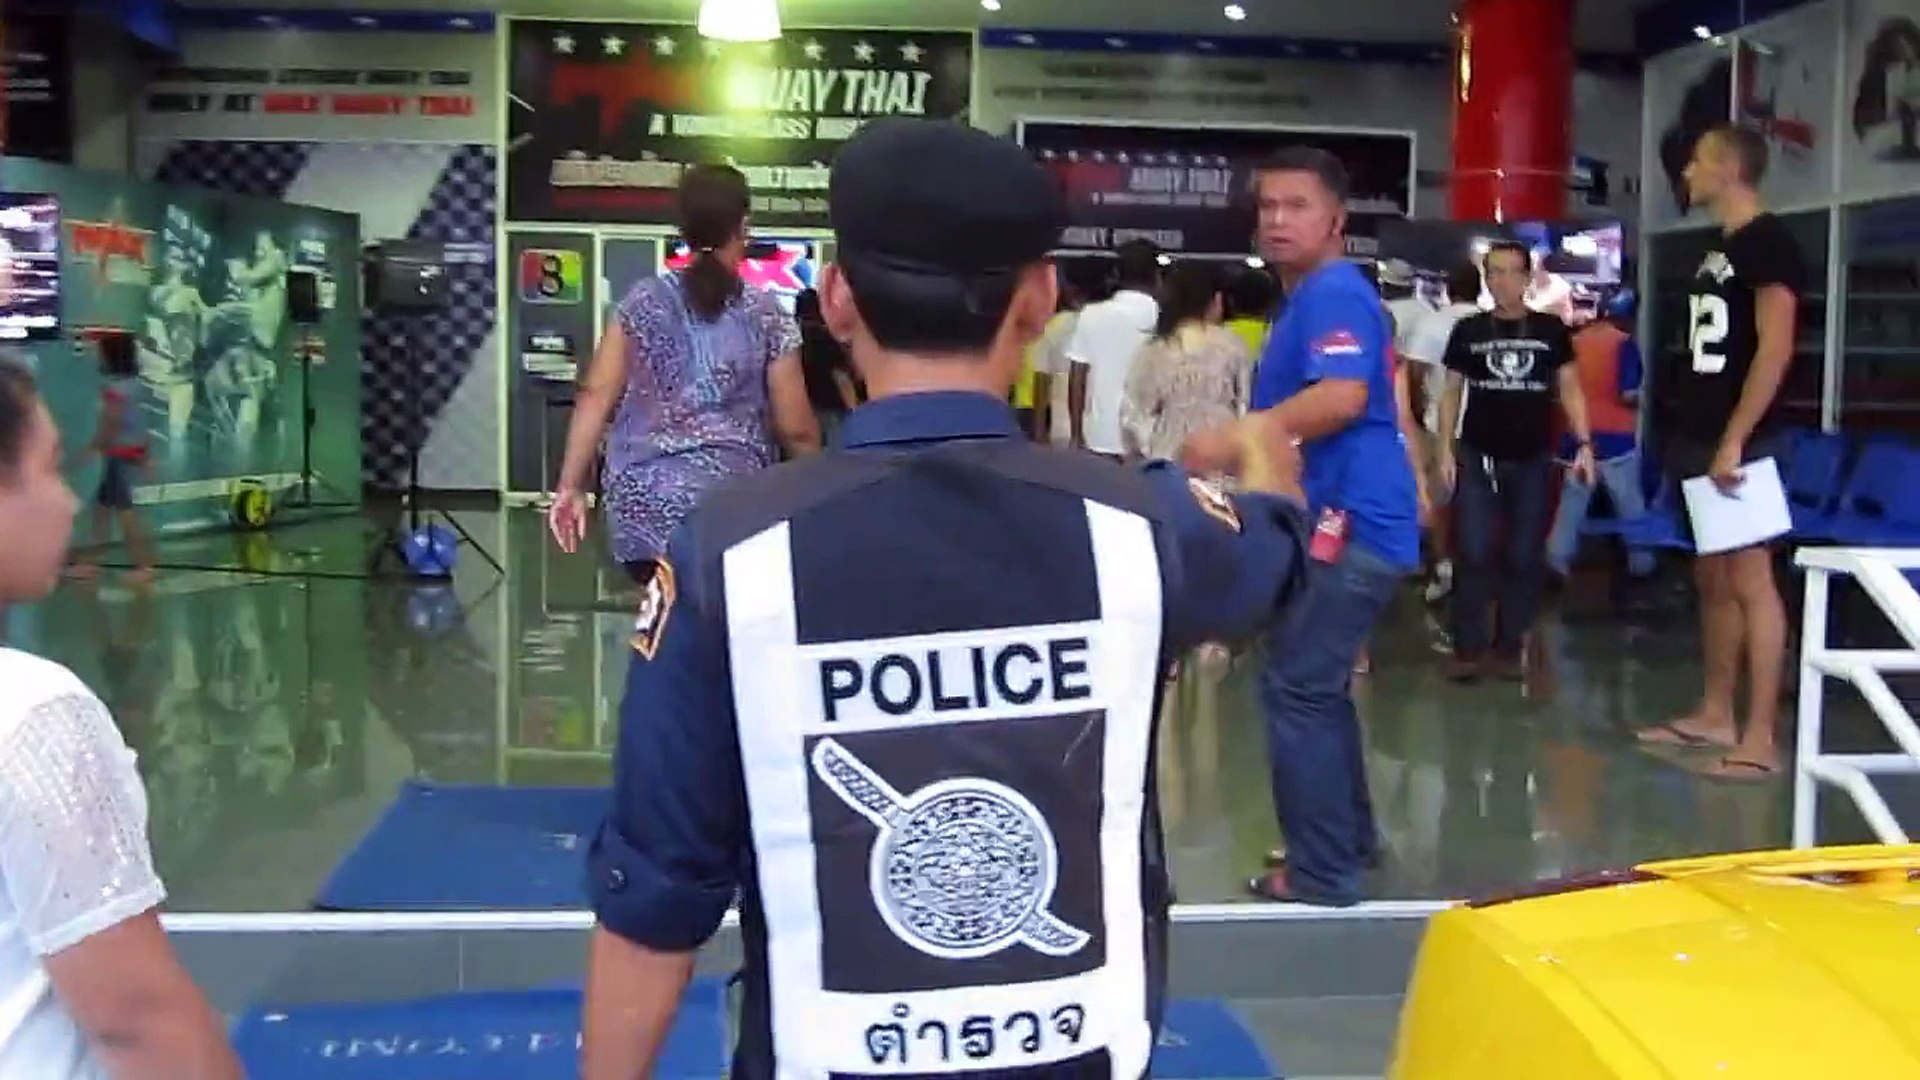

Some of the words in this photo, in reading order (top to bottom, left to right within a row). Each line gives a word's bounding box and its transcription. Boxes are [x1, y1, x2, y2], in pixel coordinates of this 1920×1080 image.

[744, 68, 838, 113] UAY
[842, 70, 932, 114] THAI
[820, 637, 1092, 721] POLICE
[865, 1002, 1086, 1065] ตำรวจ
